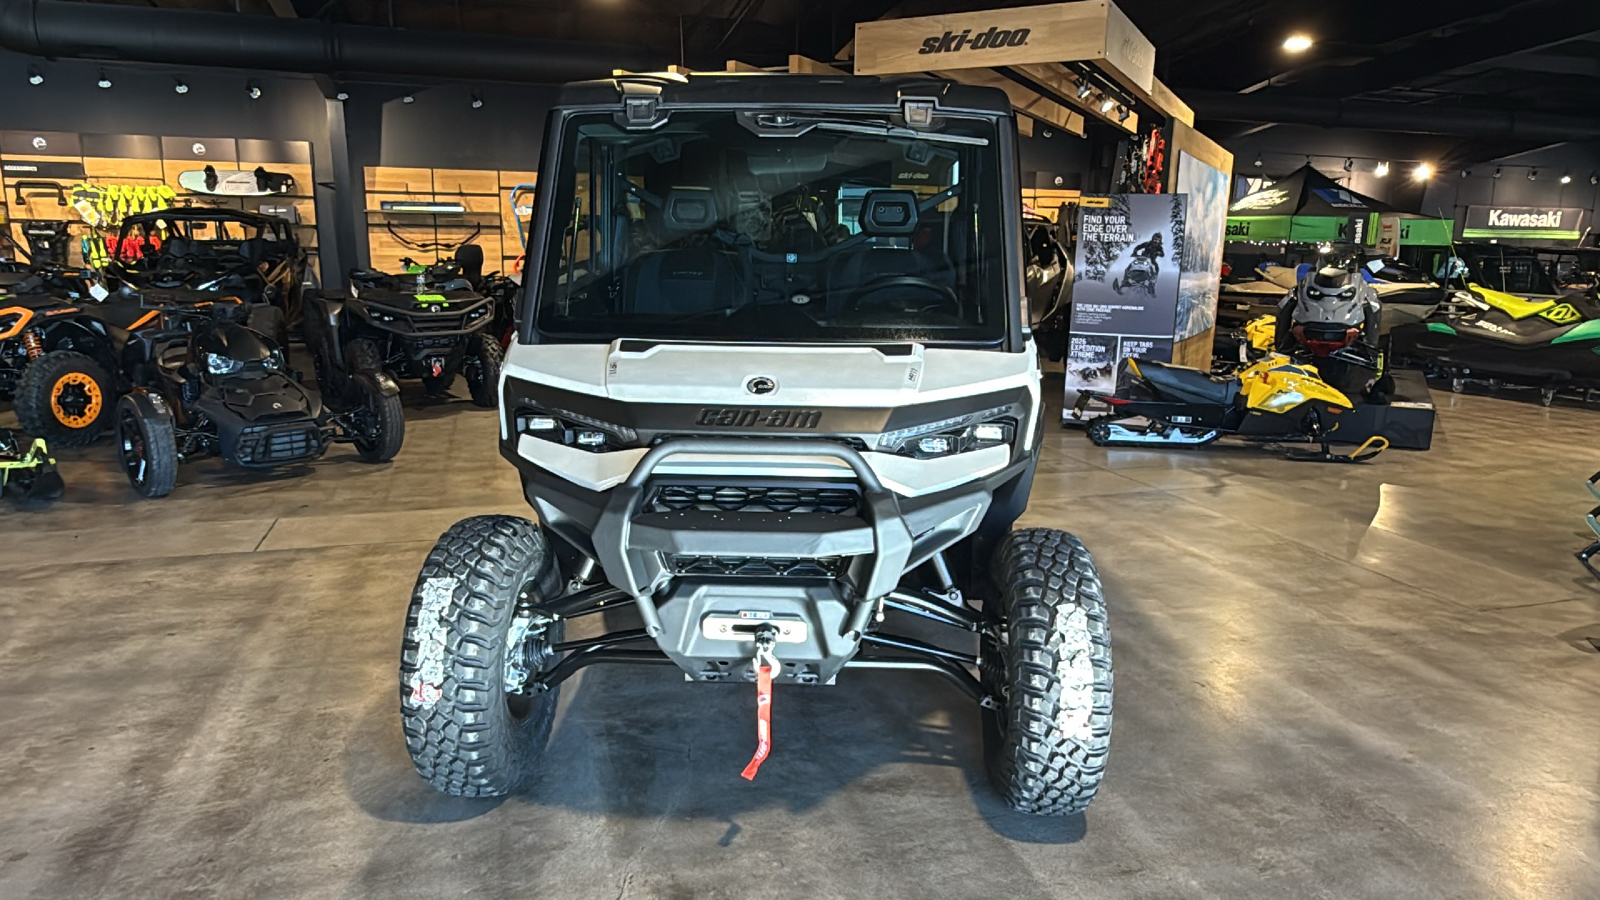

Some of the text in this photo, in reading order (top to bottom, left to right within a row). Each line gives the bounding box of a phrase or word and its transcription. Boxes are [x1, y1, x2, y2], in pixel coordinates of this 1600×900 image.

[918, 27, 1030, 55] ski-doo
[1083, 215, 1126, 224] FIND YOUR
[1488, 209, 1562, 228] Kawasaki
[1082, 223, 1128, 233] EDGE OVER
[1225, 221, 1250, 237] saki
[1354, 218, 1364, 244] asaki
[1082, 233, 1098, 242] THE
[1071, 337, 1087, 345] 2026
[1070, 344, 1106, 352] EXPEDITION
[695, 407, 823, 429] can-am
